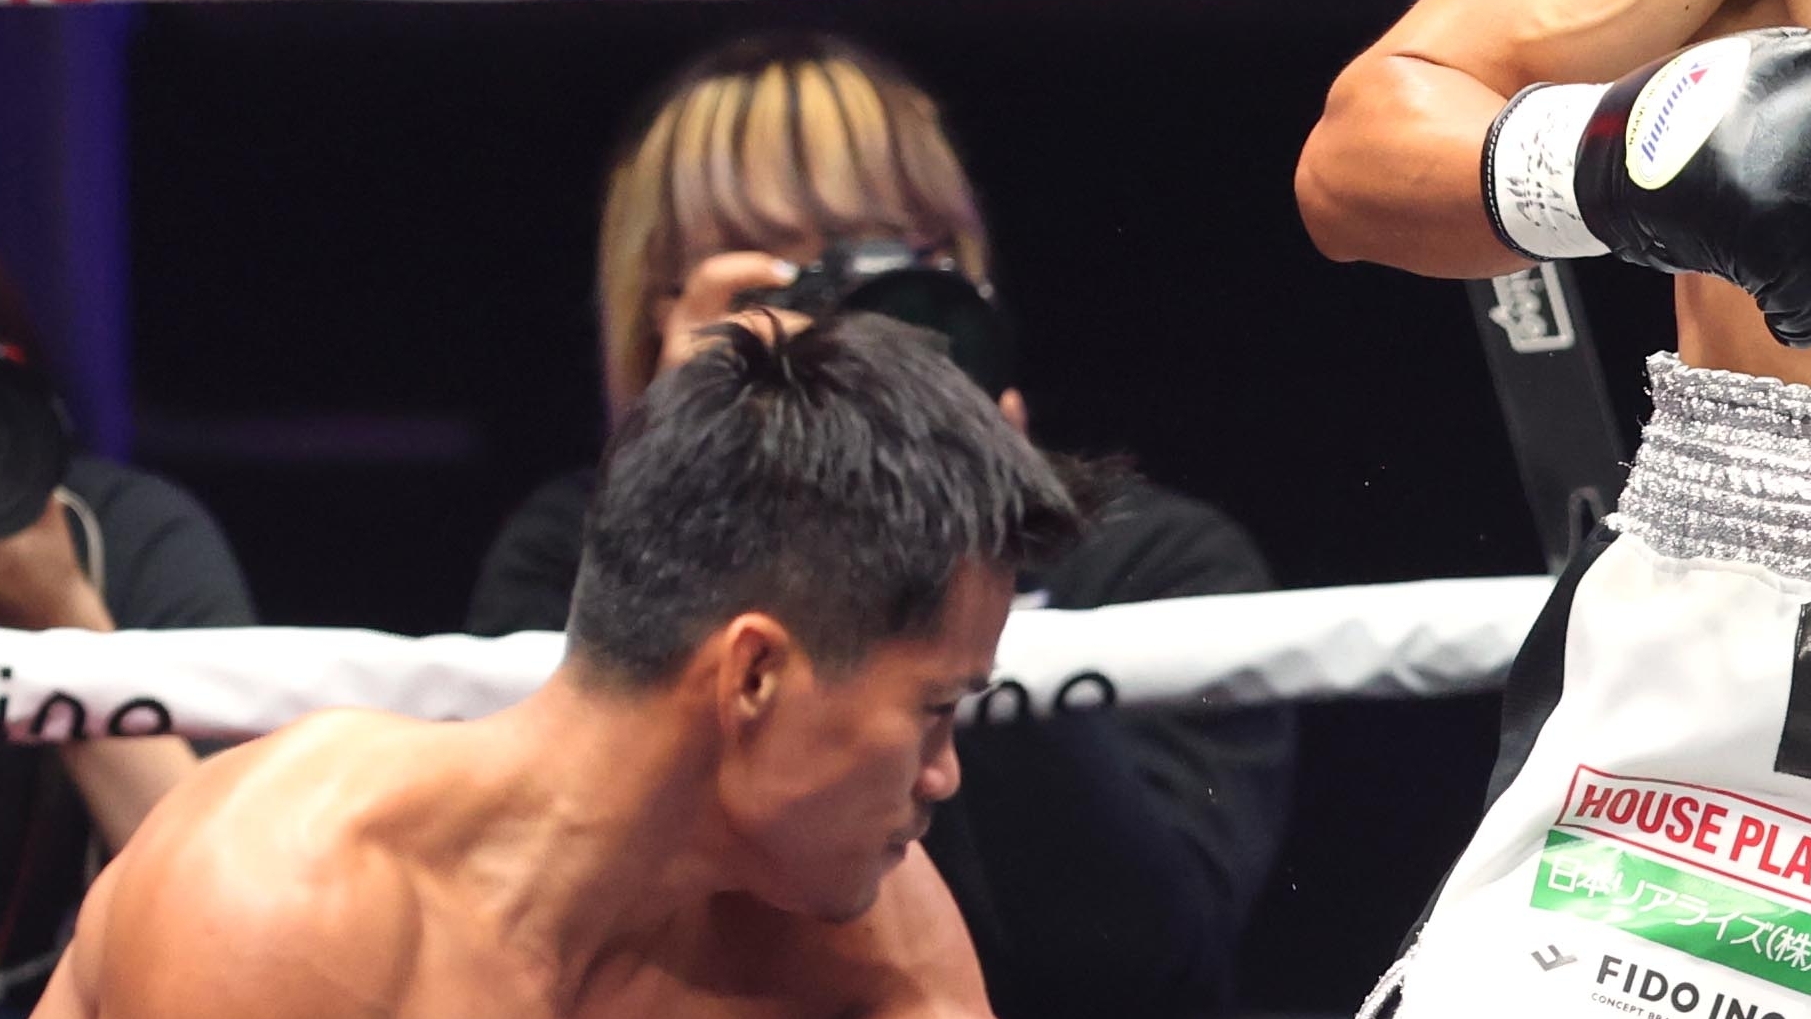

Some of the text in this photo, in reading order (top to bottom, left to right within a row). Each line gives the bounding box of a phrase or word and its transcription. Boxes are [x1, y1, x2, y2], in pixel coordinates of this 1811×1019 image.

[1574, 784, 1730, 855] HOUSE
[1591, 992, 1644, 1017] CONCEPT
[1595, 954, 1786, 1019] FIDO IN
